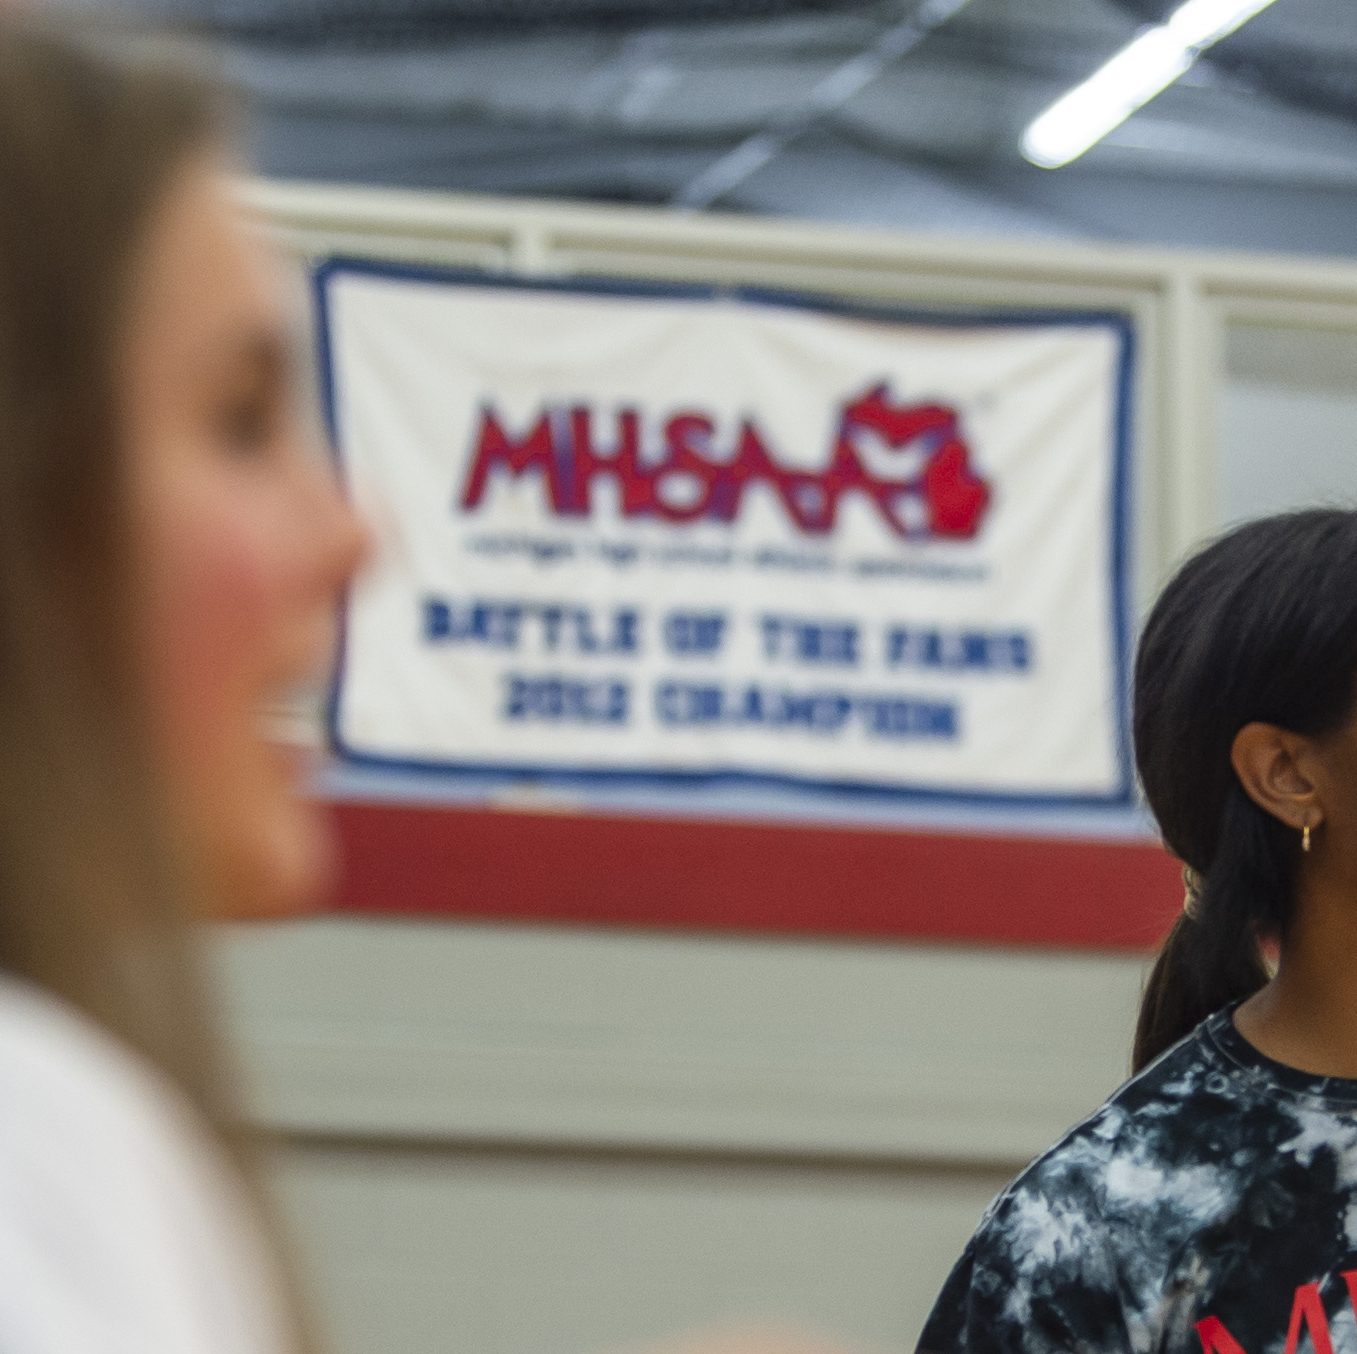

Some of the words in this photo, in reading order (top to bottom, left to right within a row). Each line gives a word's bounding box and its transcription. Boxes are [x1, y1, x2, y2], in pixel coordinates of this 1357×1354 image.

[458, 390, 944, 540] MHSAA
[422, 598, 640, 656] BATTLE
[662, 610, 728, 661] OF
[759, 613, 861, 668] THE
[886, 623, 1032, 676] FANS
[653, 678, 961, 742] CHAMPION
